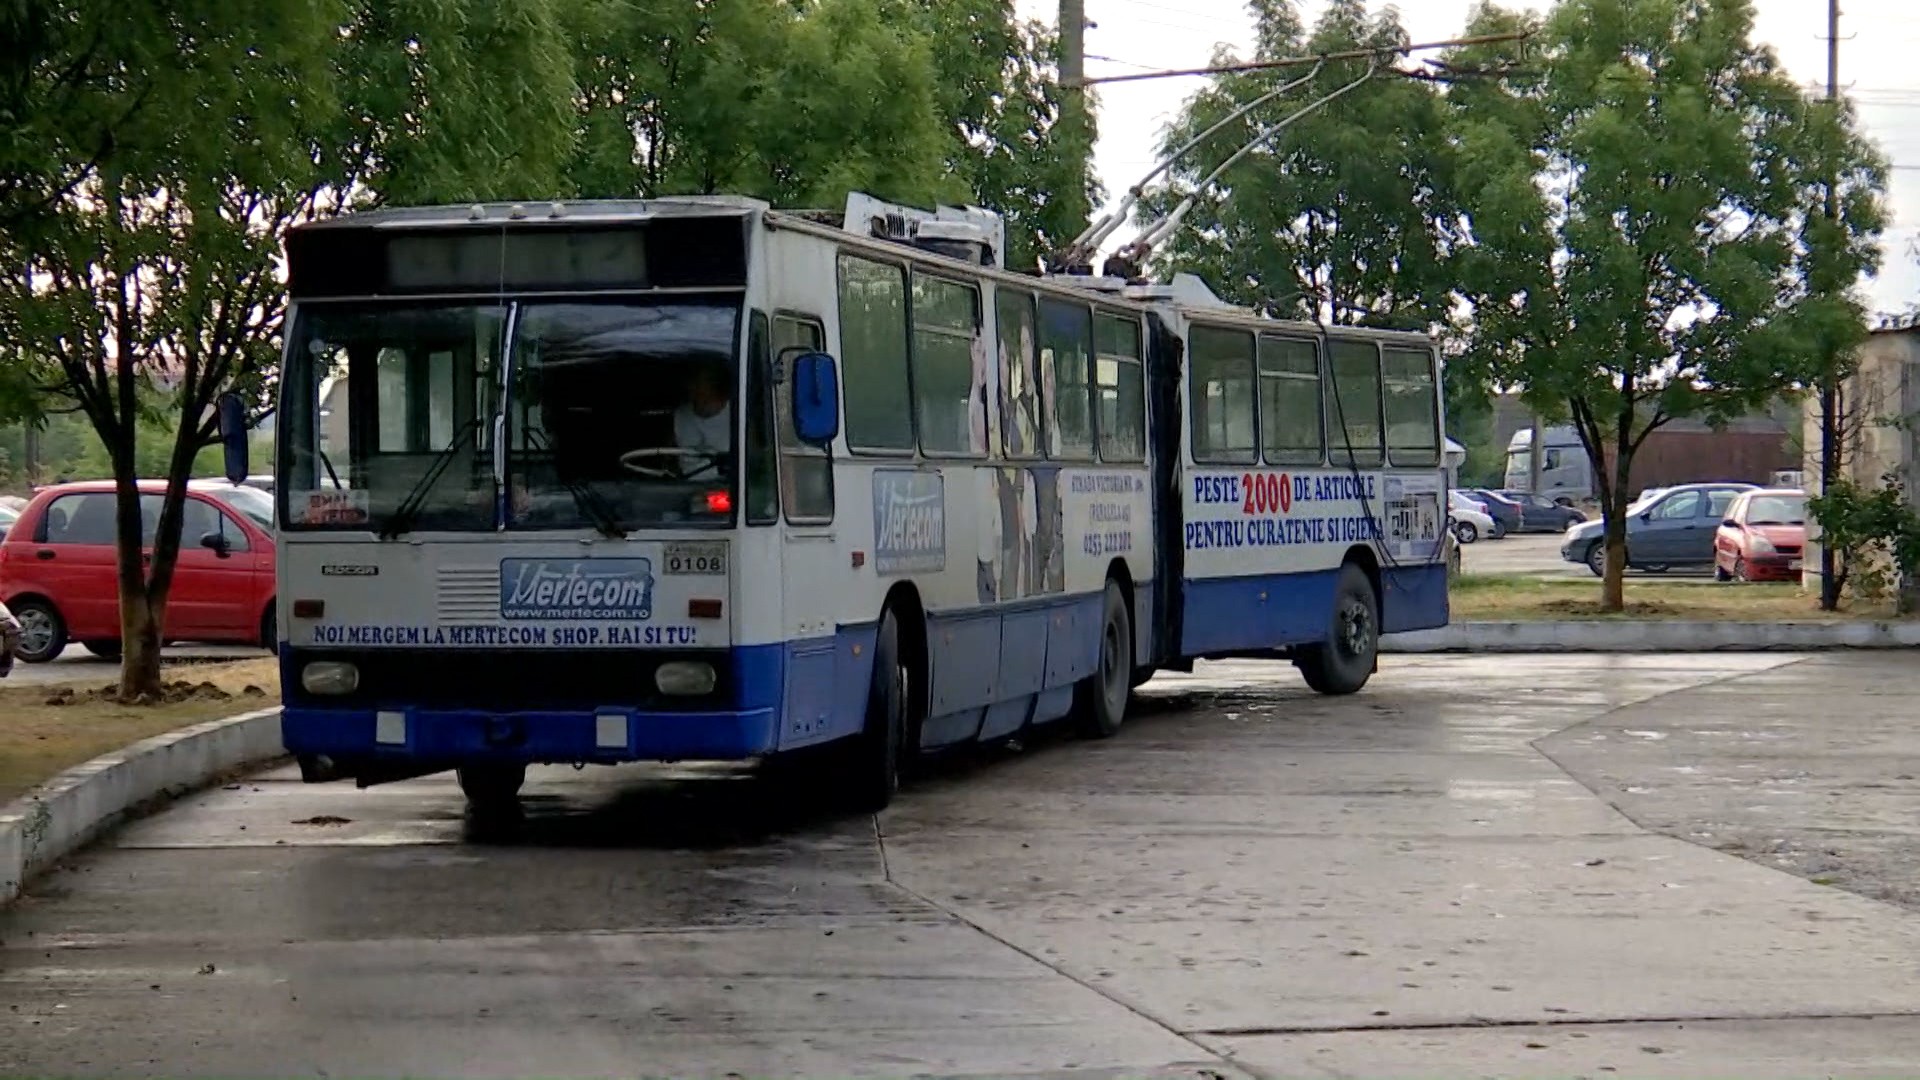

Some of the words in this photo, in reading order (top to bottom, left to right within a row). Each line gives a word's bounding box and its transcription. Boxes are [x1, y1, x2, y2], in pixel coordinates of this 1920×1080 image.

[1194, 476, 1239, 503] PESTE
[1242, 473, 1291, 515] 2000
[1294, 476, 1312, 501] DE
[1315, 475, 1375, 501] ARTICOLE
[1185, 520, 1244, 550] PENTRU
[1247, 518, 1324, 546] CURATENIE
[1327, 517, 1339, 542] SI
[670, 557, 722, 571] 0108
[506, 562, 646, 607] Mertecom
[504, 608, 649, 619] www.mertecom.ro
[314, 625, 344, 643] NOI
[348, 625, 419, 644] MERGEM
[423, 626, 447, 644] LA
[450, 626, 546, 645] MERTECOM
[552, 626, 604, 645] SHOP.
[607, 626, 642, 645] HAI
[644, 626, 662, 645] SI
[666, 625, 697, 644] TU!
